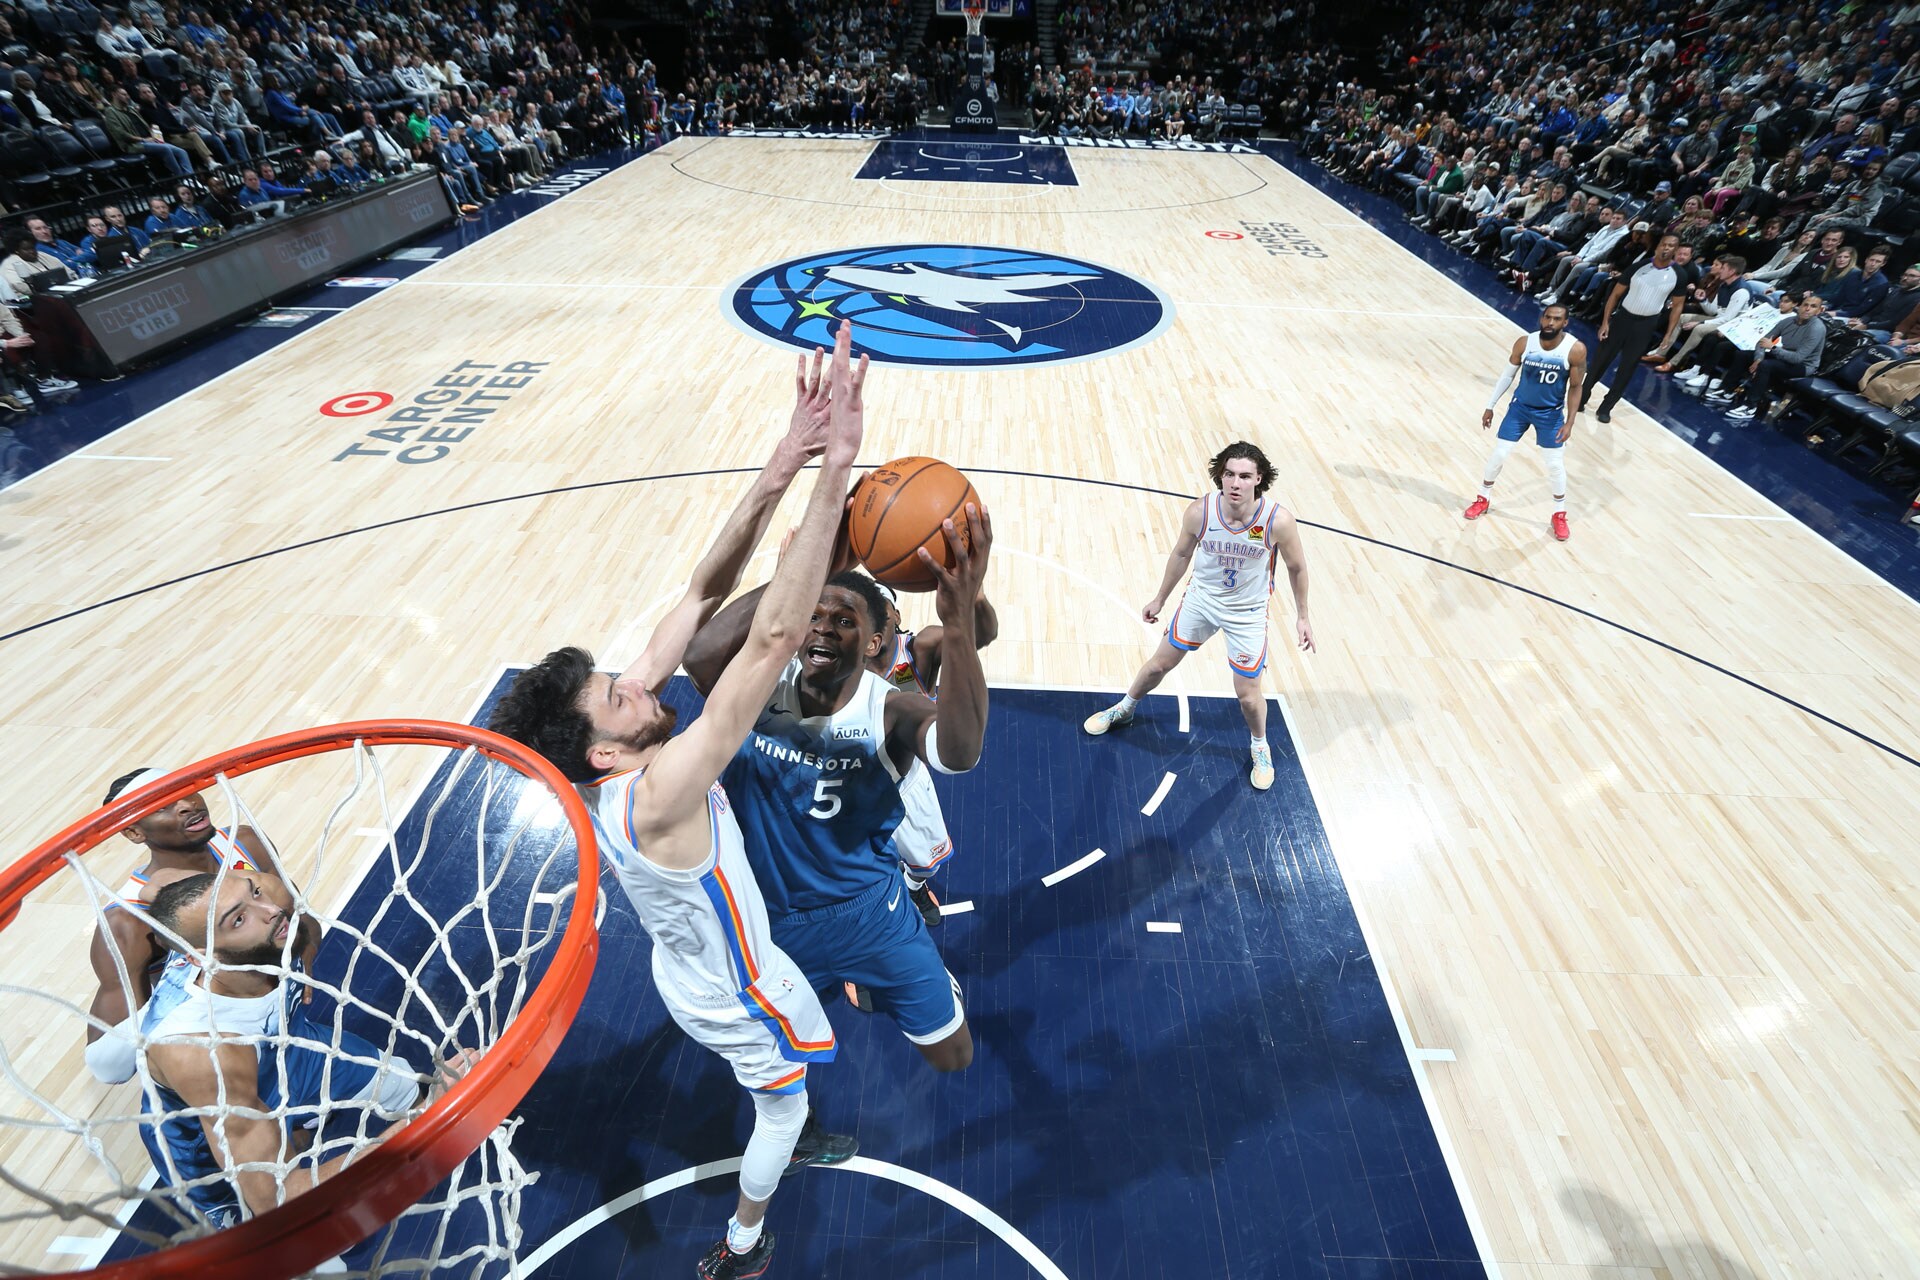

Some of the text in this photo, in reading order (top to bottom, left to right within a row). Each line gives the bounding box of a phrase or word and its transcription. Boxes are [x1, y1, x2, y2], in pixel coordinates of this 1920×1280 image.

[955, 116, 993, 124] CFMOTO
[1018, 134, 1261, 154] MINNESOTA
[1238, 220, 1296, 256] TARGET
[1267, 222, 1329, 258] CENTER
[96, 283, 190, 334] DISCOUNT
[135, 312, 175, 335] TIRE
[1524, 360, 1561, 370] MINNESOTA
[1539, 370, 1559, 384] 10
[331, 360, 499, 462] TARGET
[396, 360, 551, 465] CENTER
[1202, 540, 1266, 560] OKLAHOMA
[1218, 555, 1246, 569] CITY
[1222, 569, 1239, 589] 3
[755, 735, 862, 771] MINNESOTA
[808, 779, 843, 820] 5
